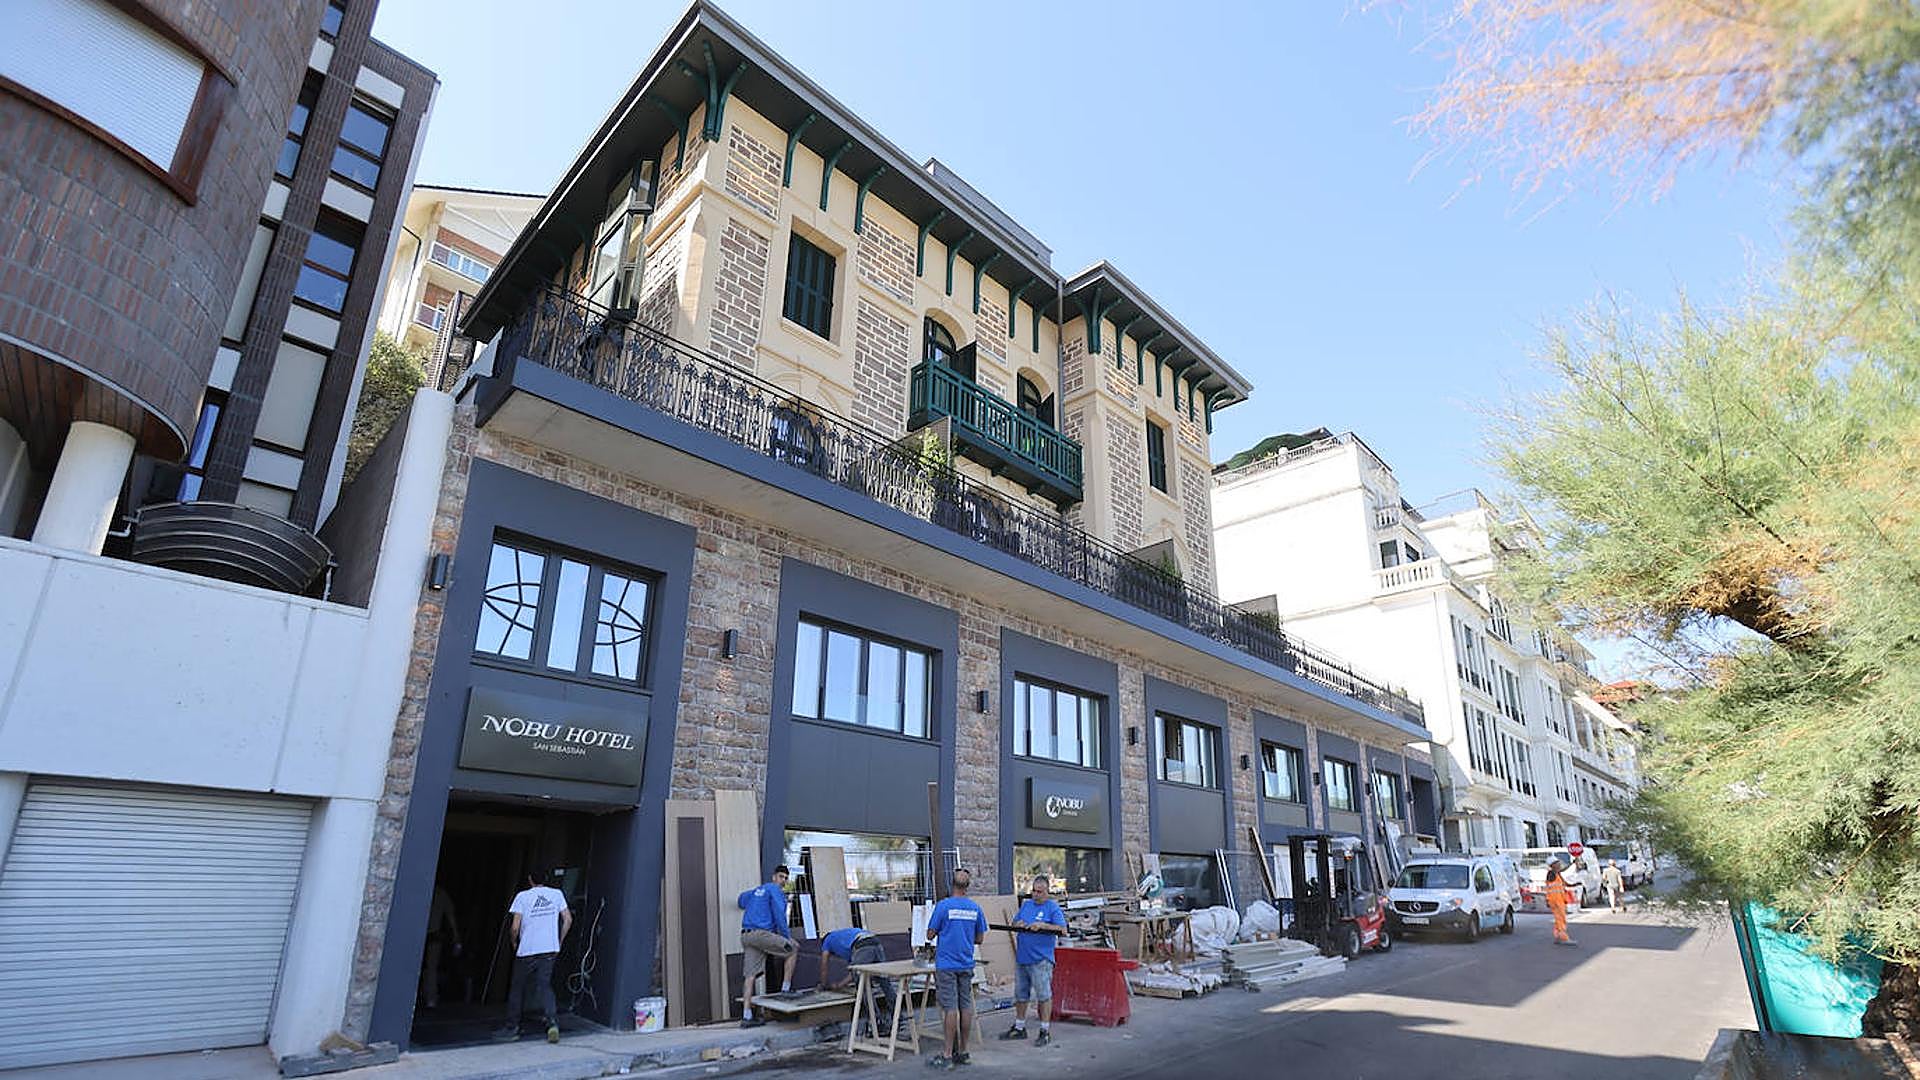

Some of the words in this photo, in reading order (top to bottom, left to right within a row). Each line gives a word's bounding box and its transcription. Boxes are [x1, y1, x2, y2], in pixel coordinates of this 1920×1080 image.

[481, 715, 561, 739] NOBU
[564, 727, 634, 750] HOTEL
[533, 742, 549, 751] SAN
[1056, 797, 1084, 810] NOBU
